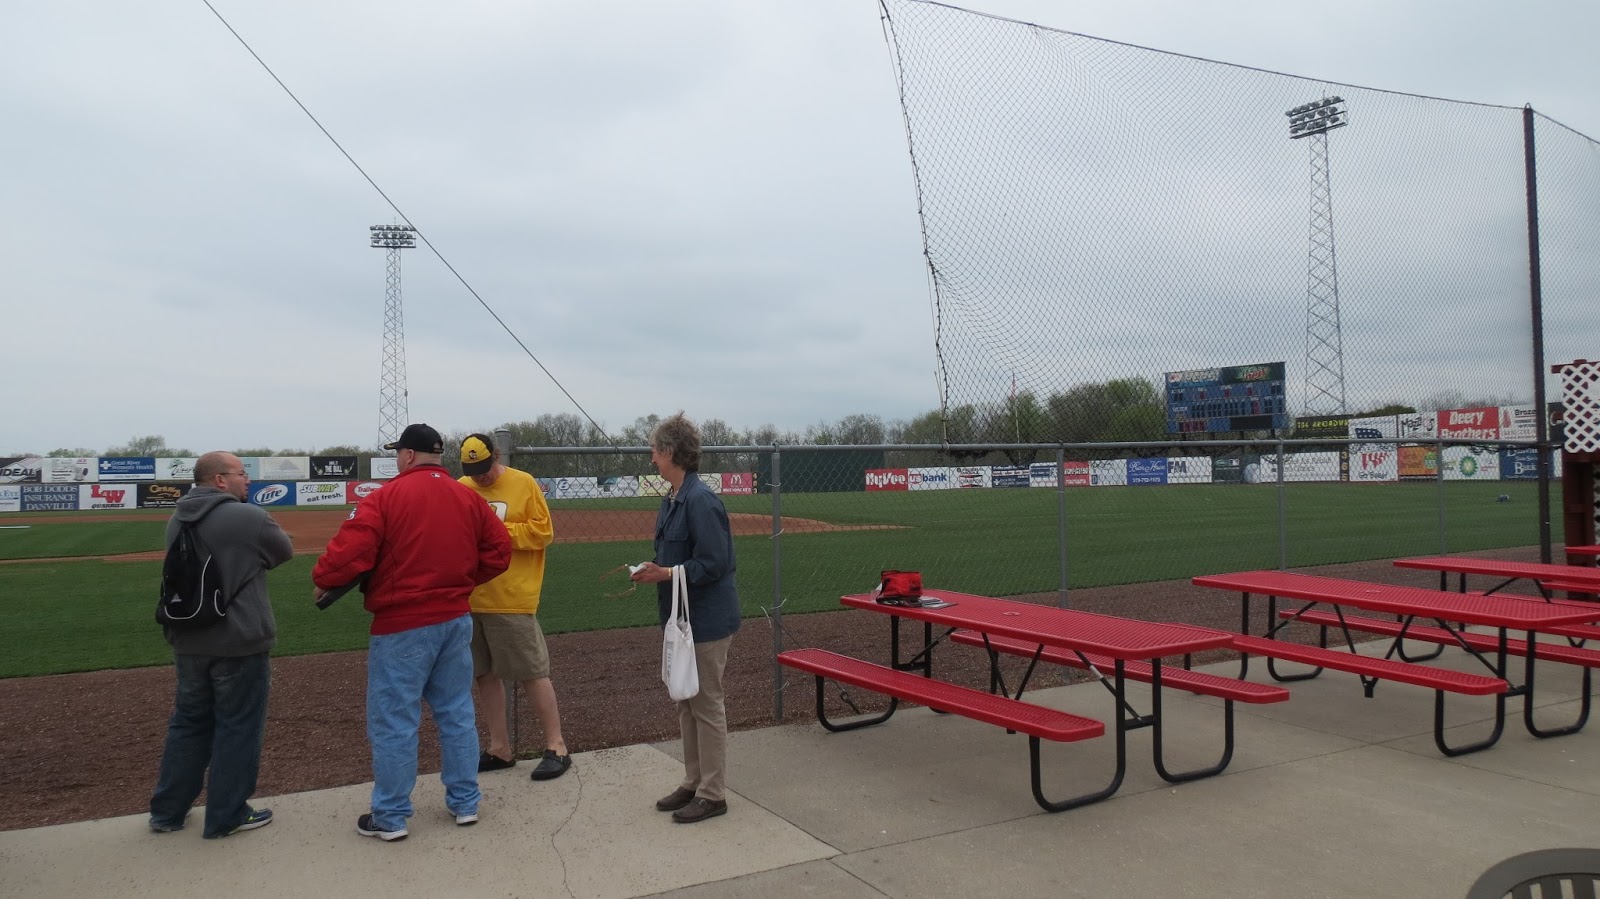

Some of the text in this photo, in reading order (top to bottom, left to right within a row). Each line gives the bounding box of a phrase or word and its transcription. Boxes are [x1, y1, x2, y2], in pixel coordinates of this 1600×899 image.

[1448, 411, 1485, 425] Deery
[1440, 427, 1497, 440] Brothers
[0, 468, 36, 477] IDEAL
[300, 483, 339, 493] SUBWAY
[24, 494, 76, 502] INSURANCE
[261, 489, 283, 502] Lite
[321, 492, 344, 501] fresh.
[26, 502, 74, 510] DANVILLE
